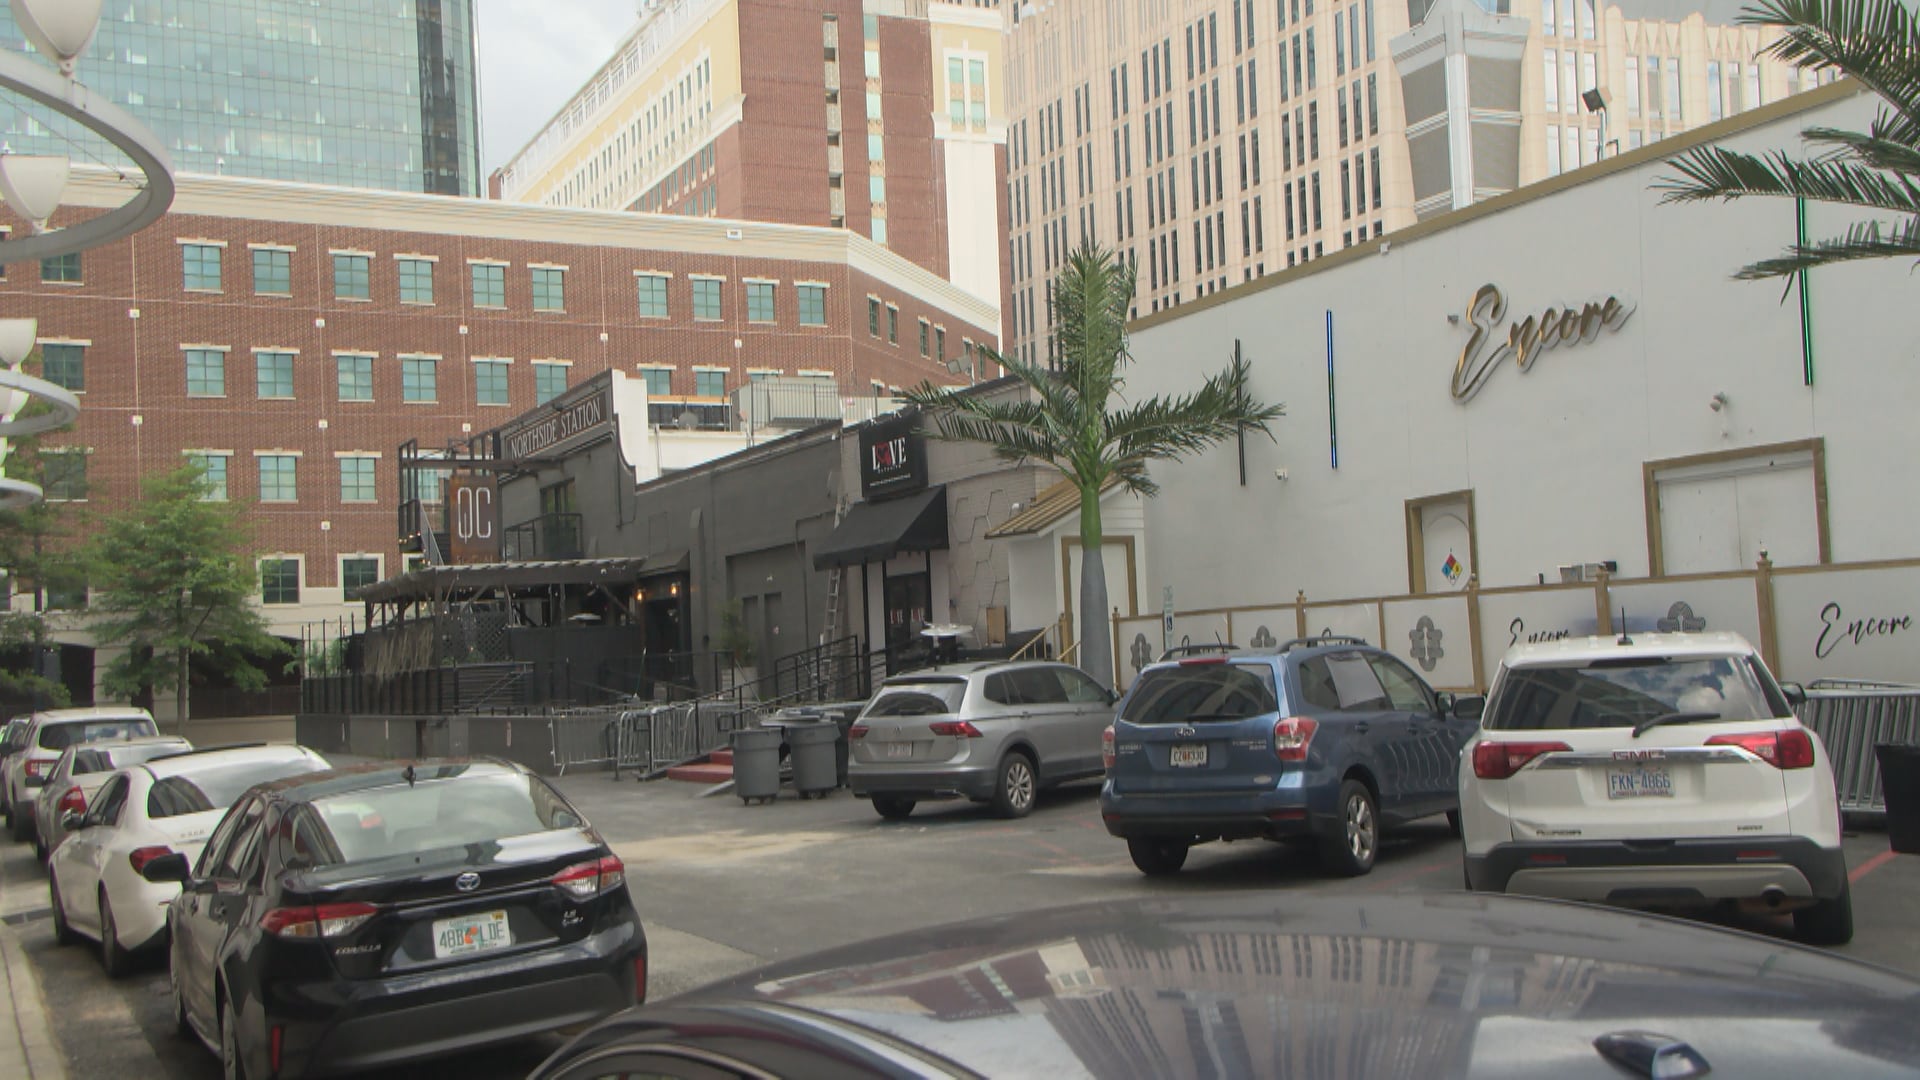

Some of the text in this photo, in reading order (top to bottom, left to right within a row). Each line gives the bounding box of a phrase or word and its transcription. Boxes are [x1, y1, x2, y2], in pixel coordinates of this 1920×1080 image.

[1450, 283, 1636, 402] Encore
[510, 397, 601, 459] NORTHSIDE STATION
[457, 486, 492, 544] QC
[1815, 601, 1912, 659] Encore
[1611, 748, 1666, 761] GMC
